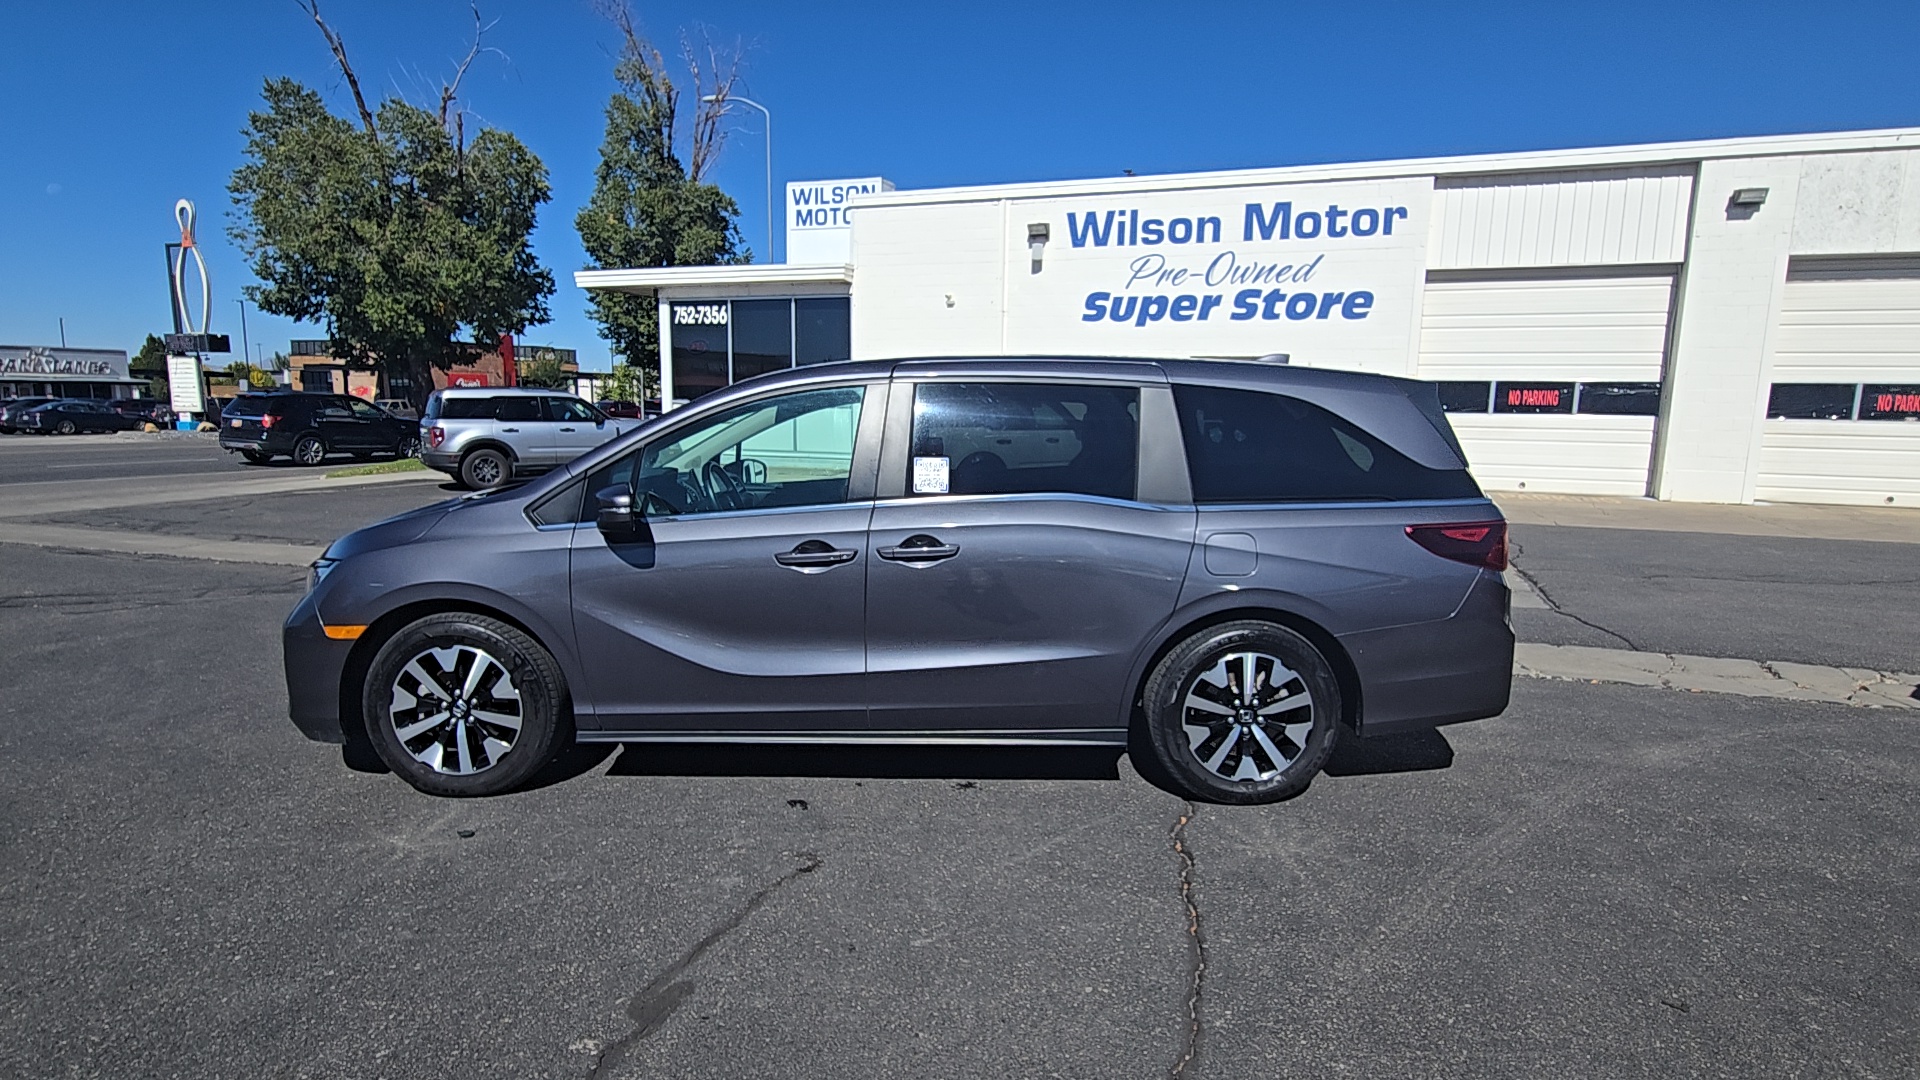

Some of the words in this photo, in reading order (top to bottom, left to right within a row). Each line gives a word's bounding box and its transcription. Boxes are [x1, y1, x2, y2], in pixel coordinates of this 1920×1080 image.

[1066, 209, 1221, 248] Wilson
[1243, 201, 1408, 241] Motor
[1125, 250, 1325, 290] Pre-Owned
[673, 304, 728, 325] 752-7356
[1081, 291, 1221, 327] Super
[1230, 288, 1374, 321] Store
[1508, 389, 1521, 406] NO
[1522, 389, 1559, 406] PARKING
[1877, 394, 1892, 412] NO
[1894, 394, 1920, 412] PARK
